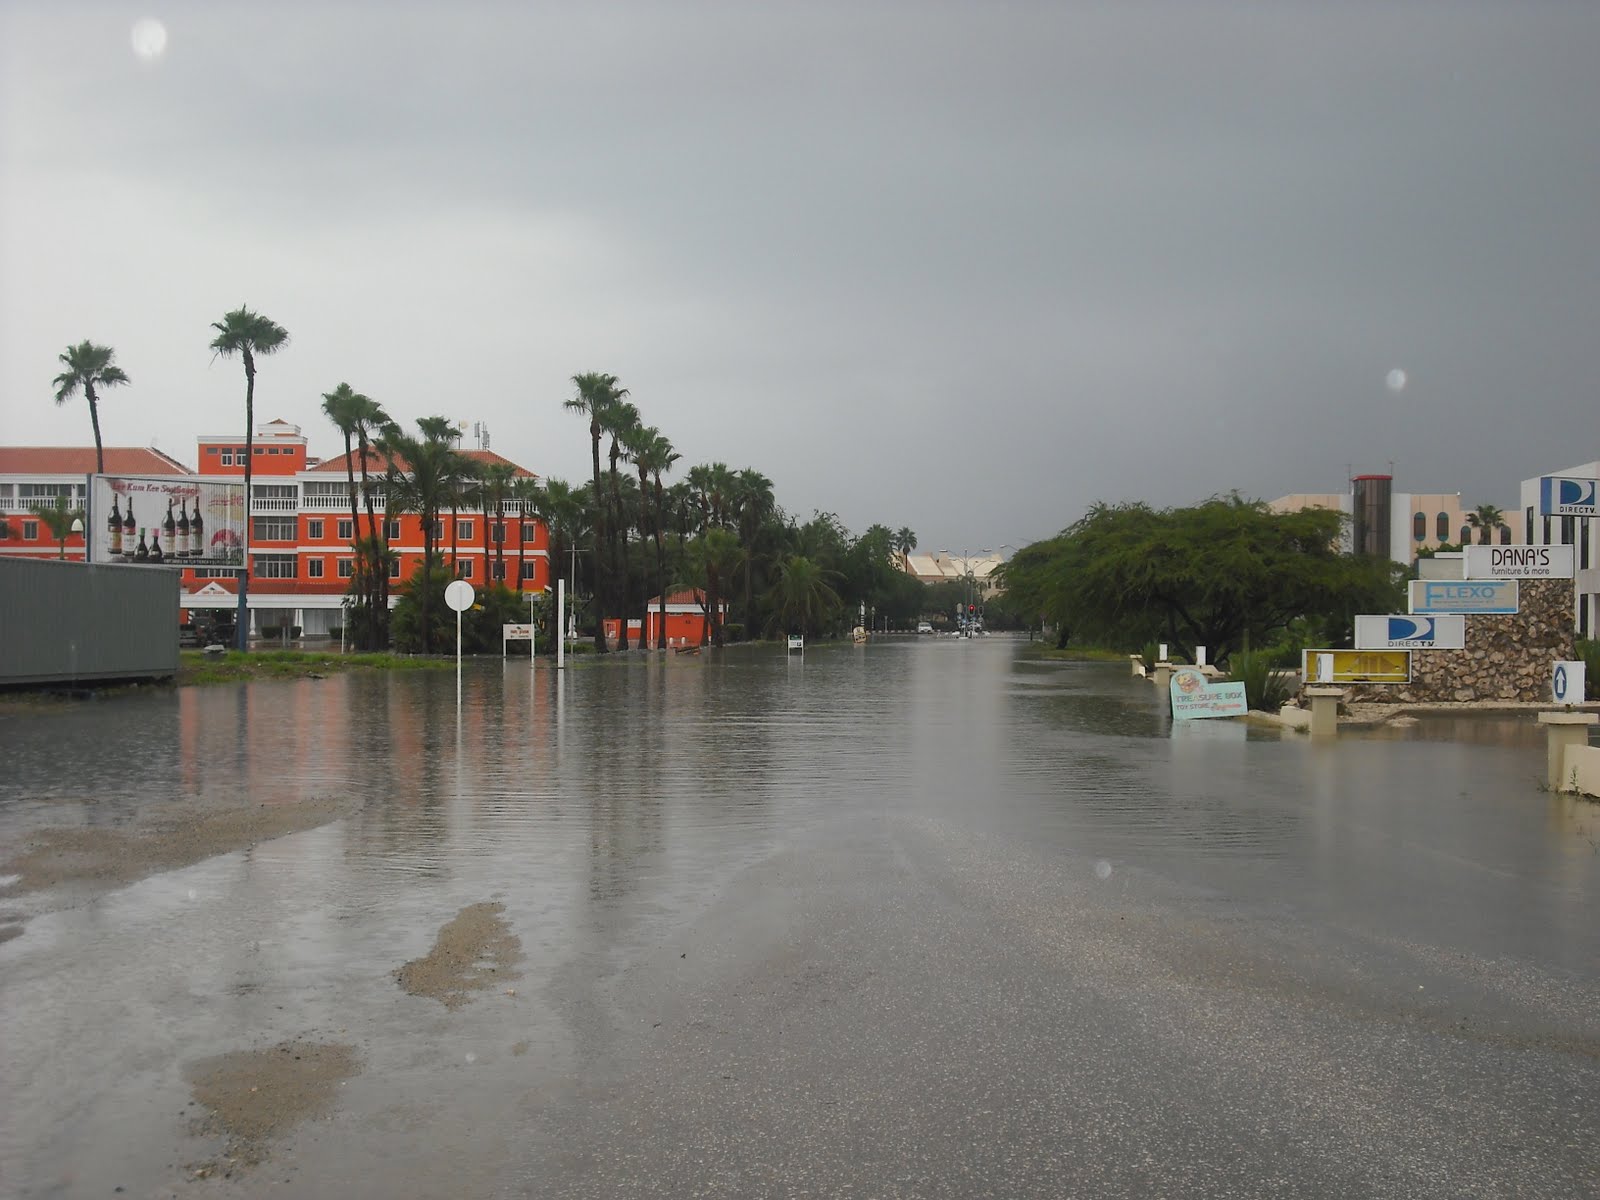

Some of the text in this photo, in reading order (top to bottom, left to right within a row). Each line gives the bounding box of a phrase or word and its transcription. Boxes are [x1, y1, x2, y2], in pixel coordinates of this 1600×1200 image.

[127, 483, 145, 491] Kum
[146, 484, 160, 492] Kee
[1559, 506, 1595, 514] DIRECTV
[1491, 549, 1550, 566] DANA'S
[1491, 567, 1522, 575] furniture
[1523, 567, 1530, 575] &
[1425, 582, 1500, 607] FLEXO
[1176, 692, 1243, 702] TREASURE BOX
